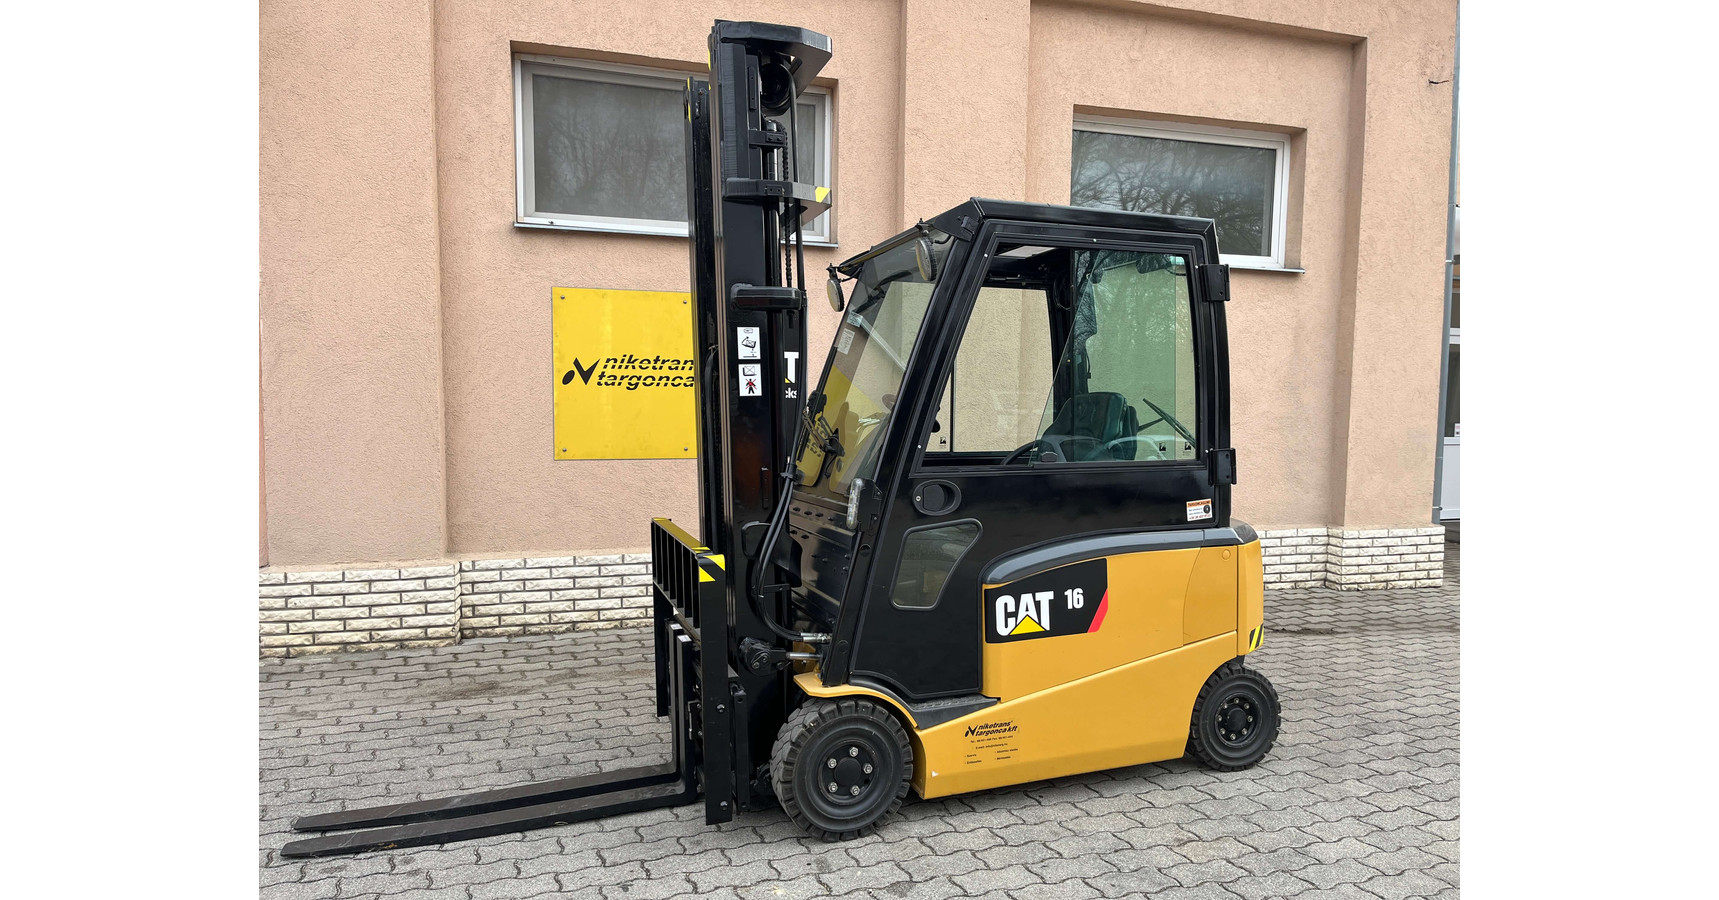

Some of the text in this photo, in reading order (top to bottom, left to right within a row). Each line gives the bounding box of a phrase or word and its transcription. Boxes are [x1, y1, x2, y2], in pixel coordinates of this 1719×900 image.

[597, 371, 694, 390] targonca
[995, 588, 1084, 636] CAT 16
